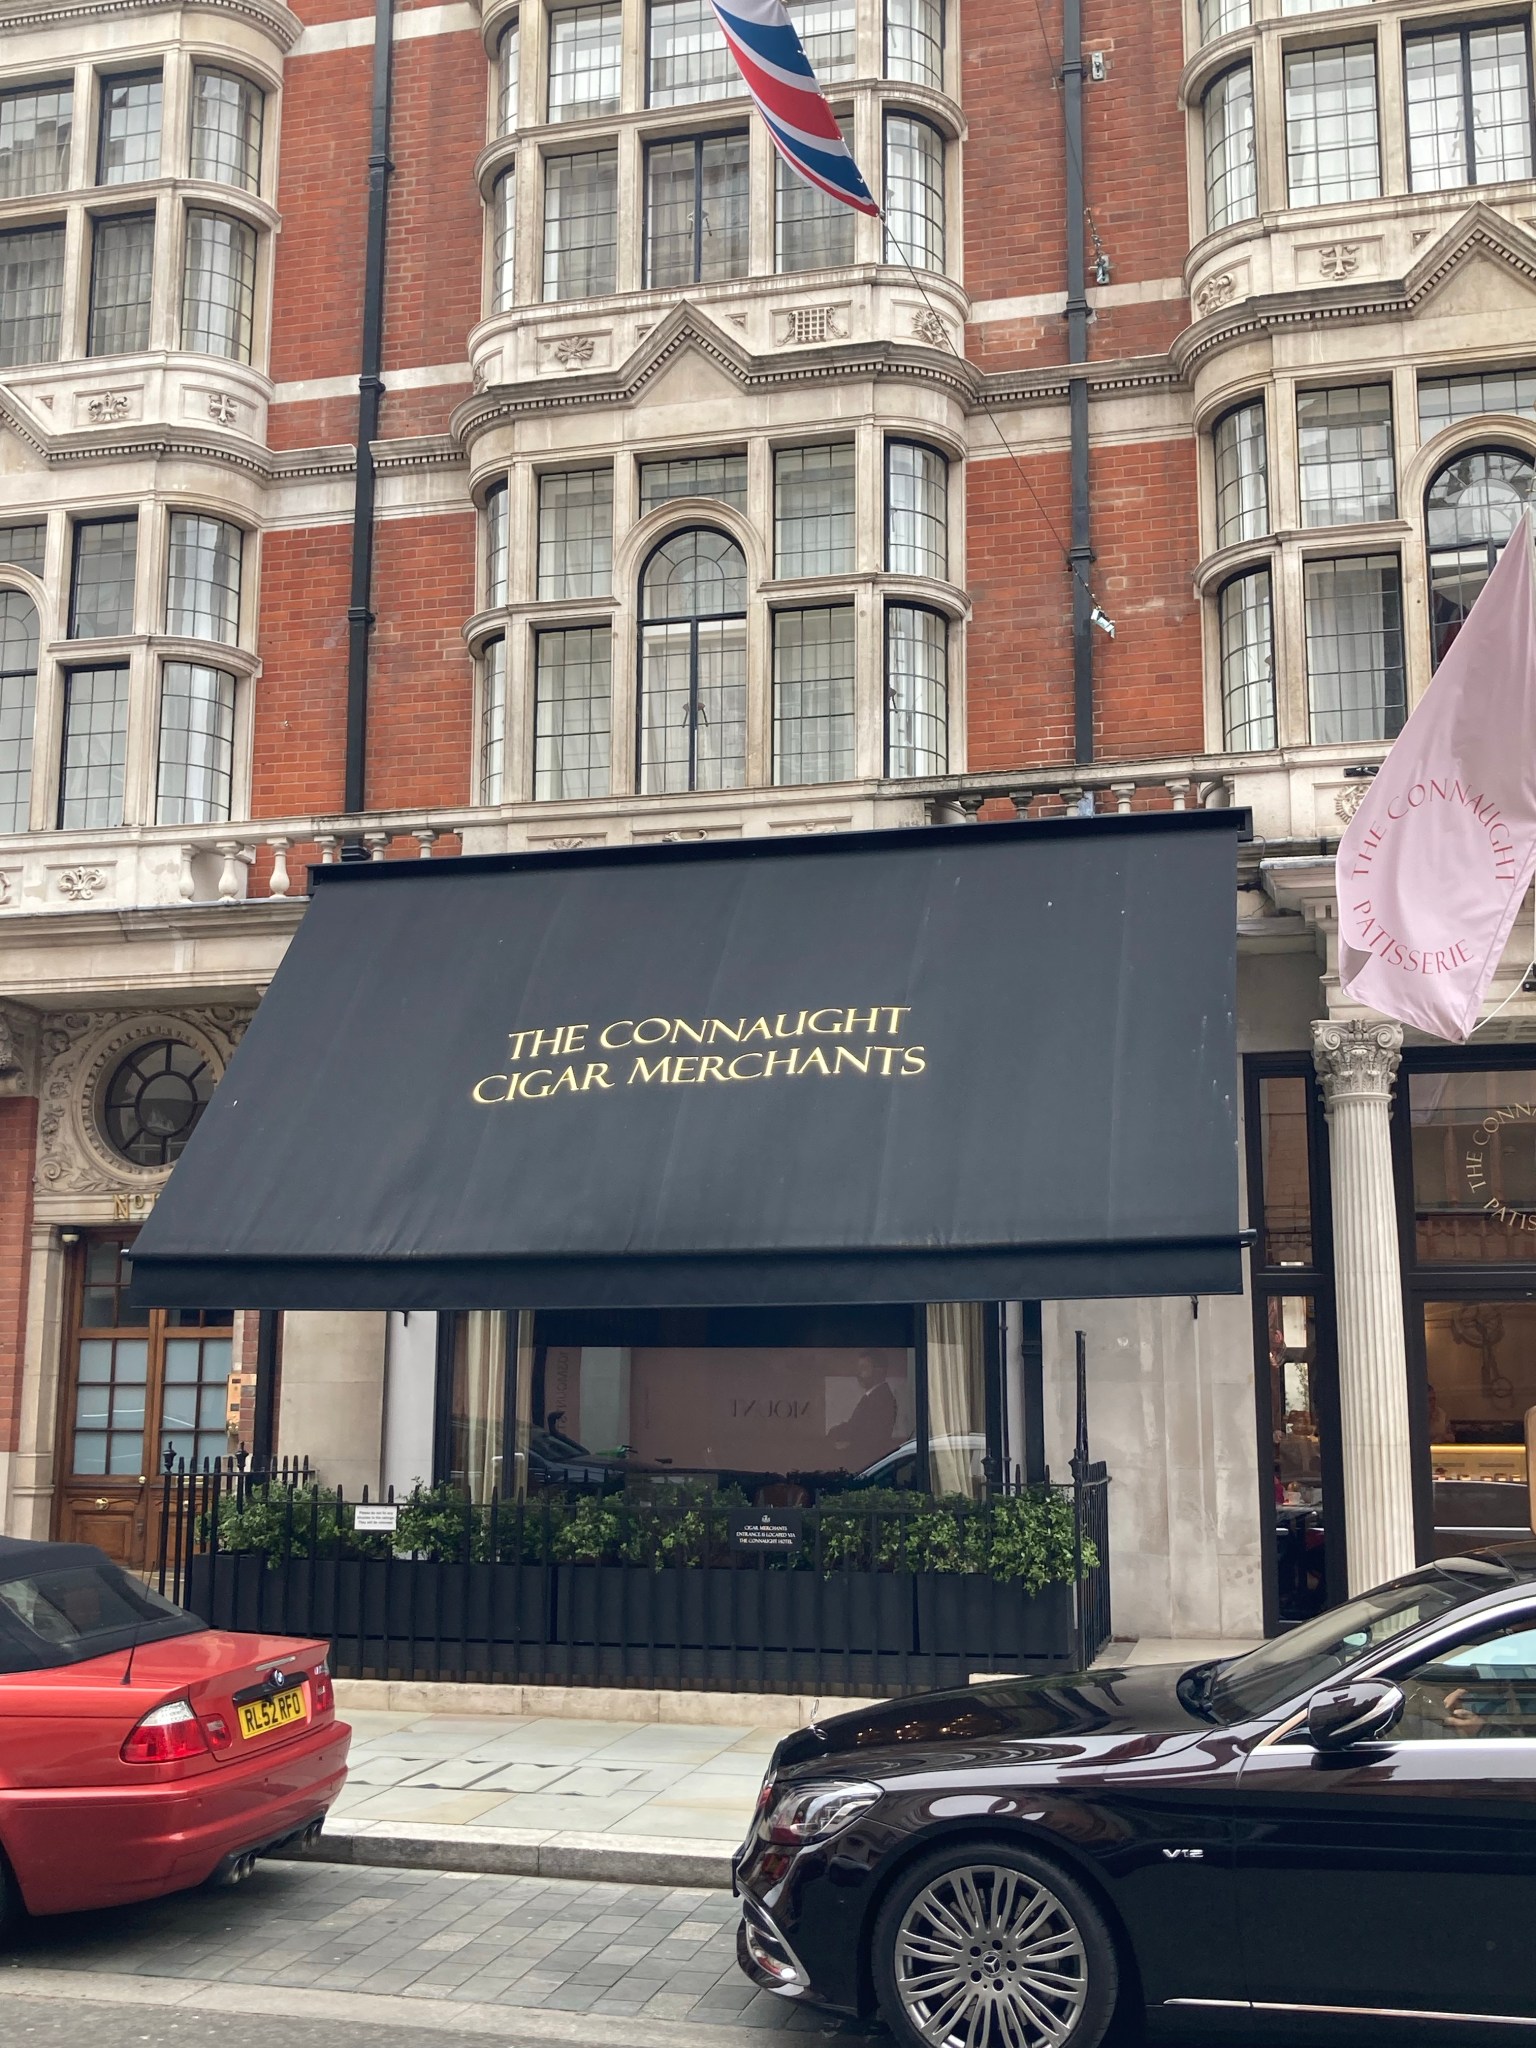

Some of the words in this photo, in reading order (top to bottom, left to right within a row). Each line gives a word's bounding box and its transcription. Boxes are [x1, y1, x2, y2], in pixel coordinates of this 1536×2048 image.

[1351, 820, 1388, 880] THE
[1387, 778, 1516, 886] CONNAUGHT
[1353, 899, 1474, 975] PATISSERIE
[508, 1023, 590, 1061] THE
[599, 1005, 912, 1050] CONNAUGHT
[471, 1060, 615, 1105] CIGAR
[627, 1044, 927, 1085] MERCHANTS
[1466, 1151, 1487, 1194] THE
[244, 1701, 278, 1732] RL52
[278, 1693, 301, 1720] RFO
[1162, 1848, 1204, 1858] V12
